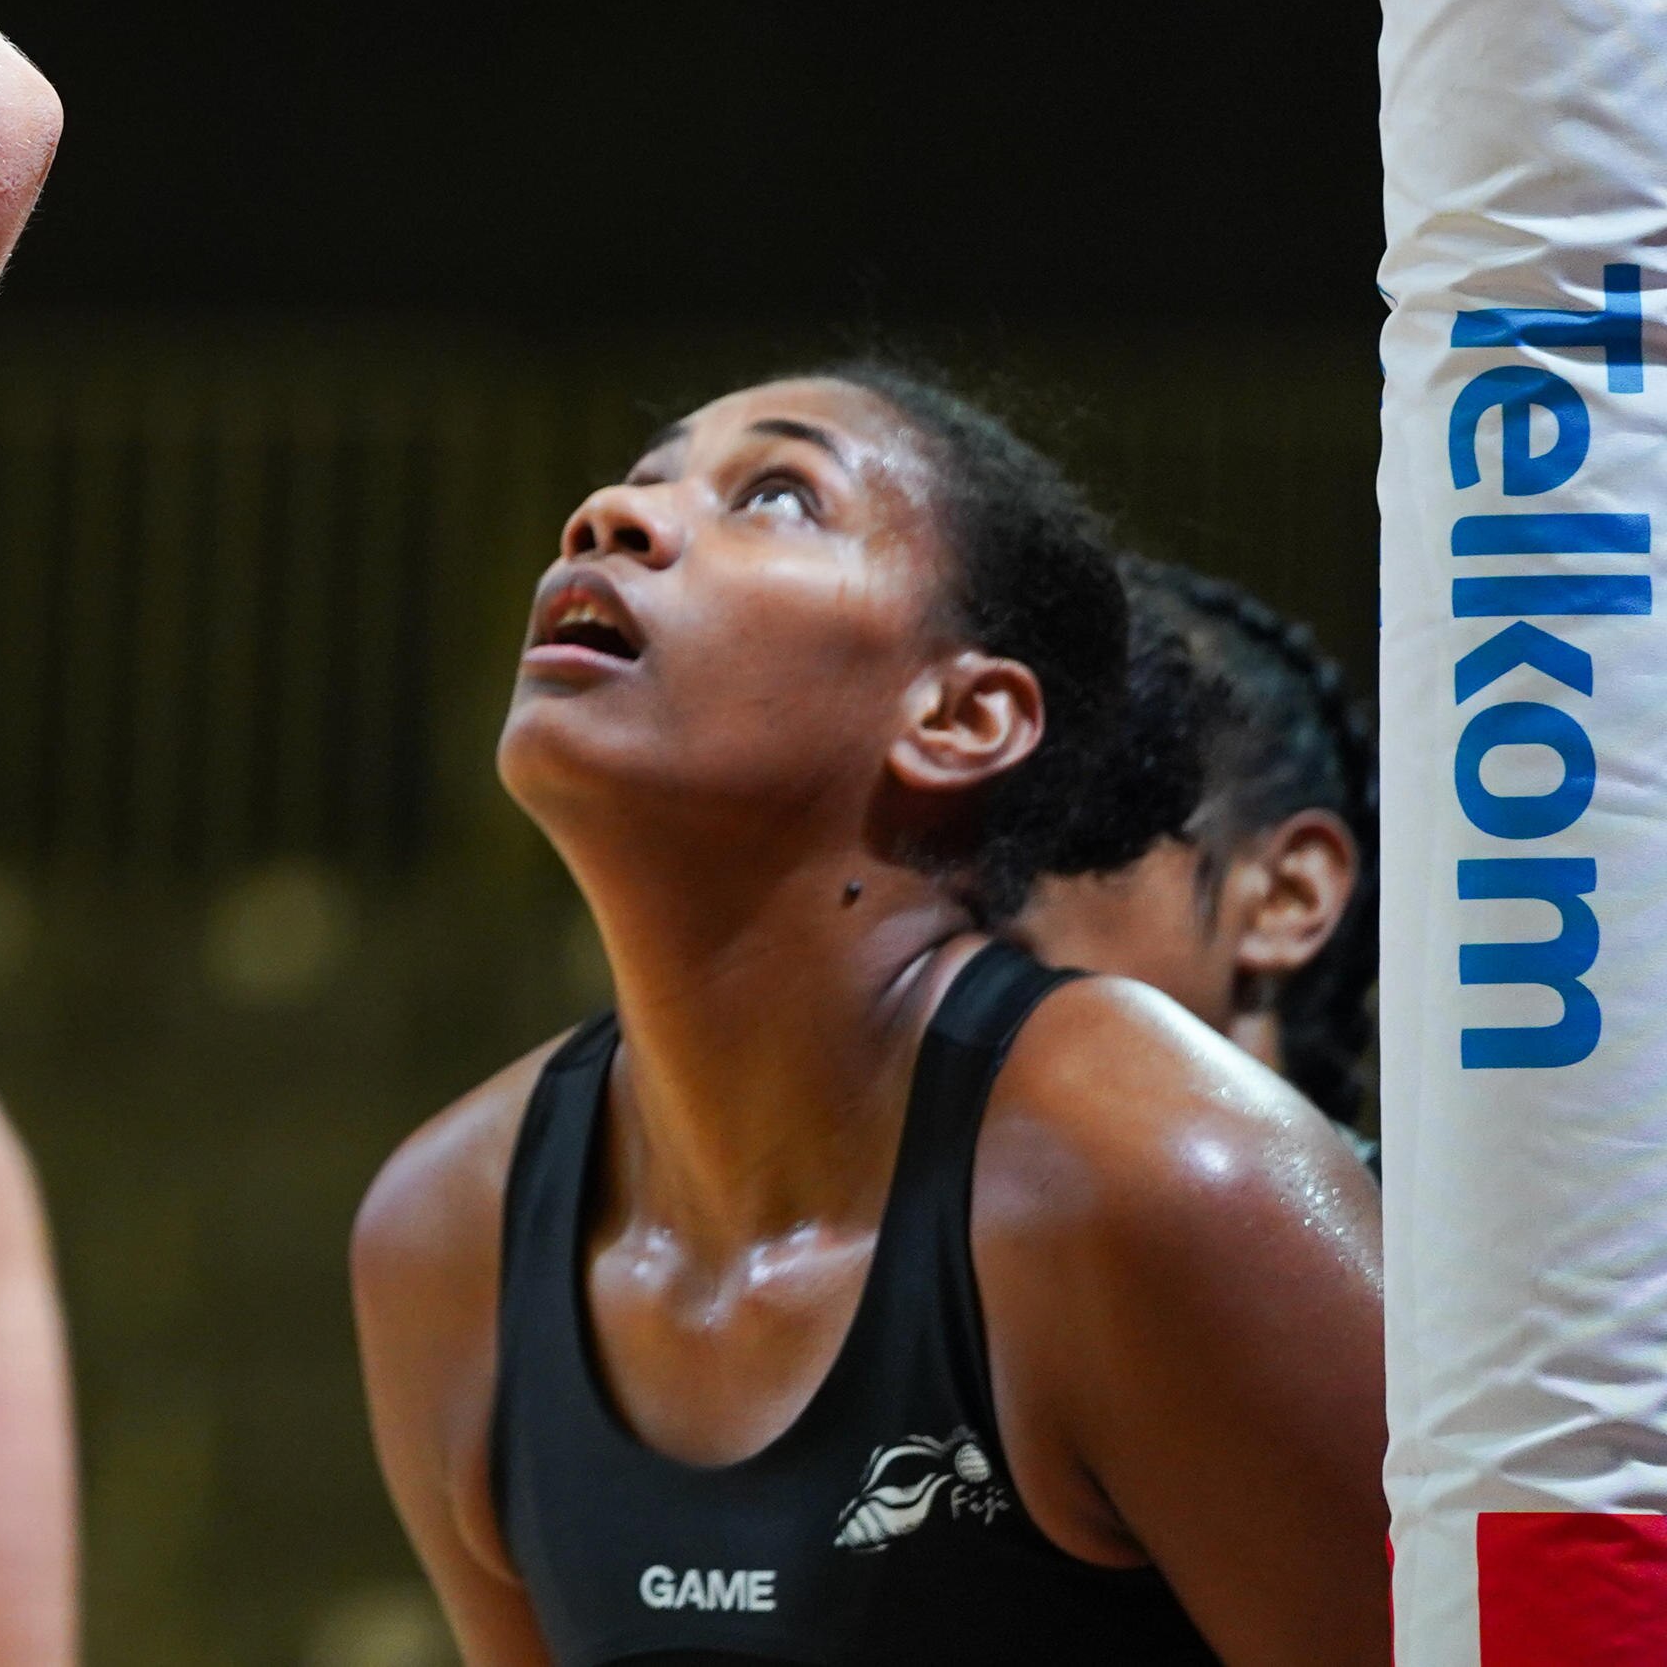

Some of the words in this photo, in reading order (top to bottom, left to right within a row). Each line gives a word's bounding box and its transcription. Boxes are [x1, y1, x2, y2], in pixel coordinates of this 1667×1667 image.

[1449, 263, 1652, 1070] Telkom
[950, 1484, 1011, 1525] Fiji
[639, 1564, 778, 1612] GAME
